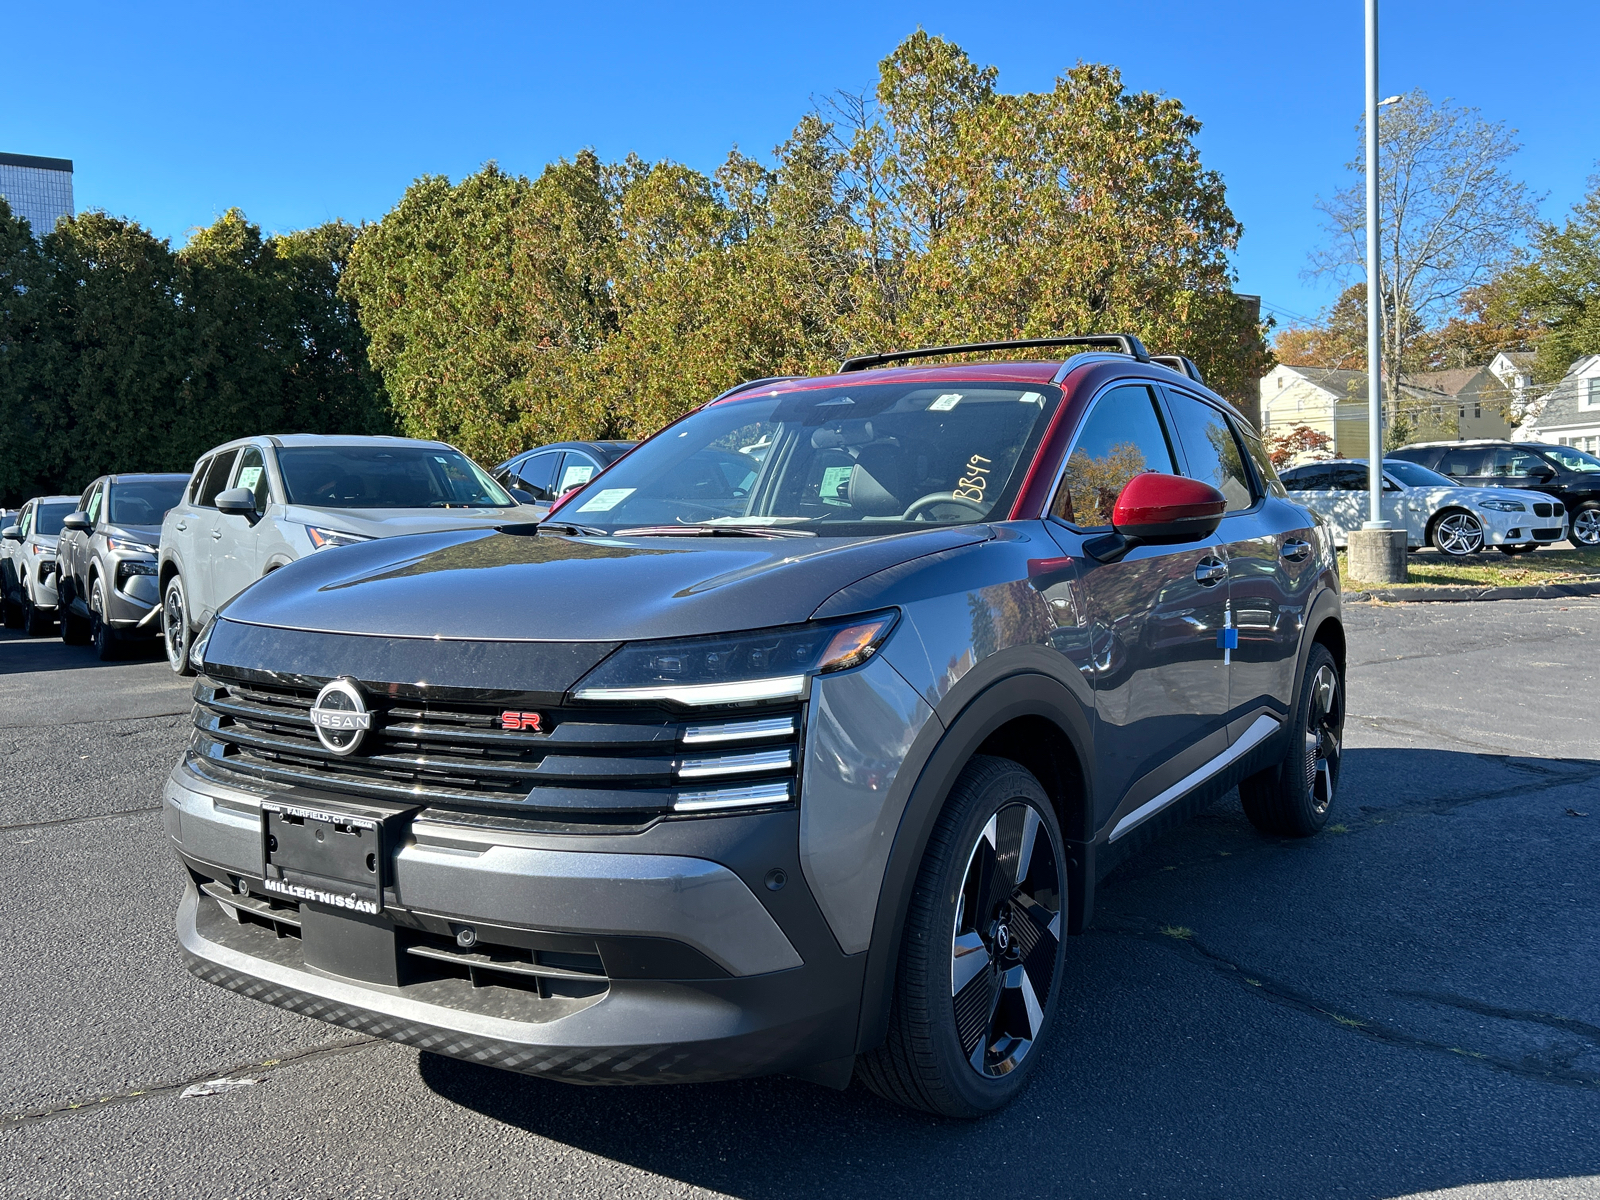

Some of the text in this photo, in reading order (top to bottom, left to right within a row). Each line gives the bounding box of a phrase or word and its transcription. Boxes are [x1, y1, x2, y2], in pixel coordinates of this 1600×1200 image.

[952, 454, 992, 503] BB49
[311, 711, 368, 727] NISSAN
[502, 711, 541, 731] SR
[286, 808, 345, 824] FAIRFIELD, CT
[265, 880, 377, 914] MILLER NISSAN
